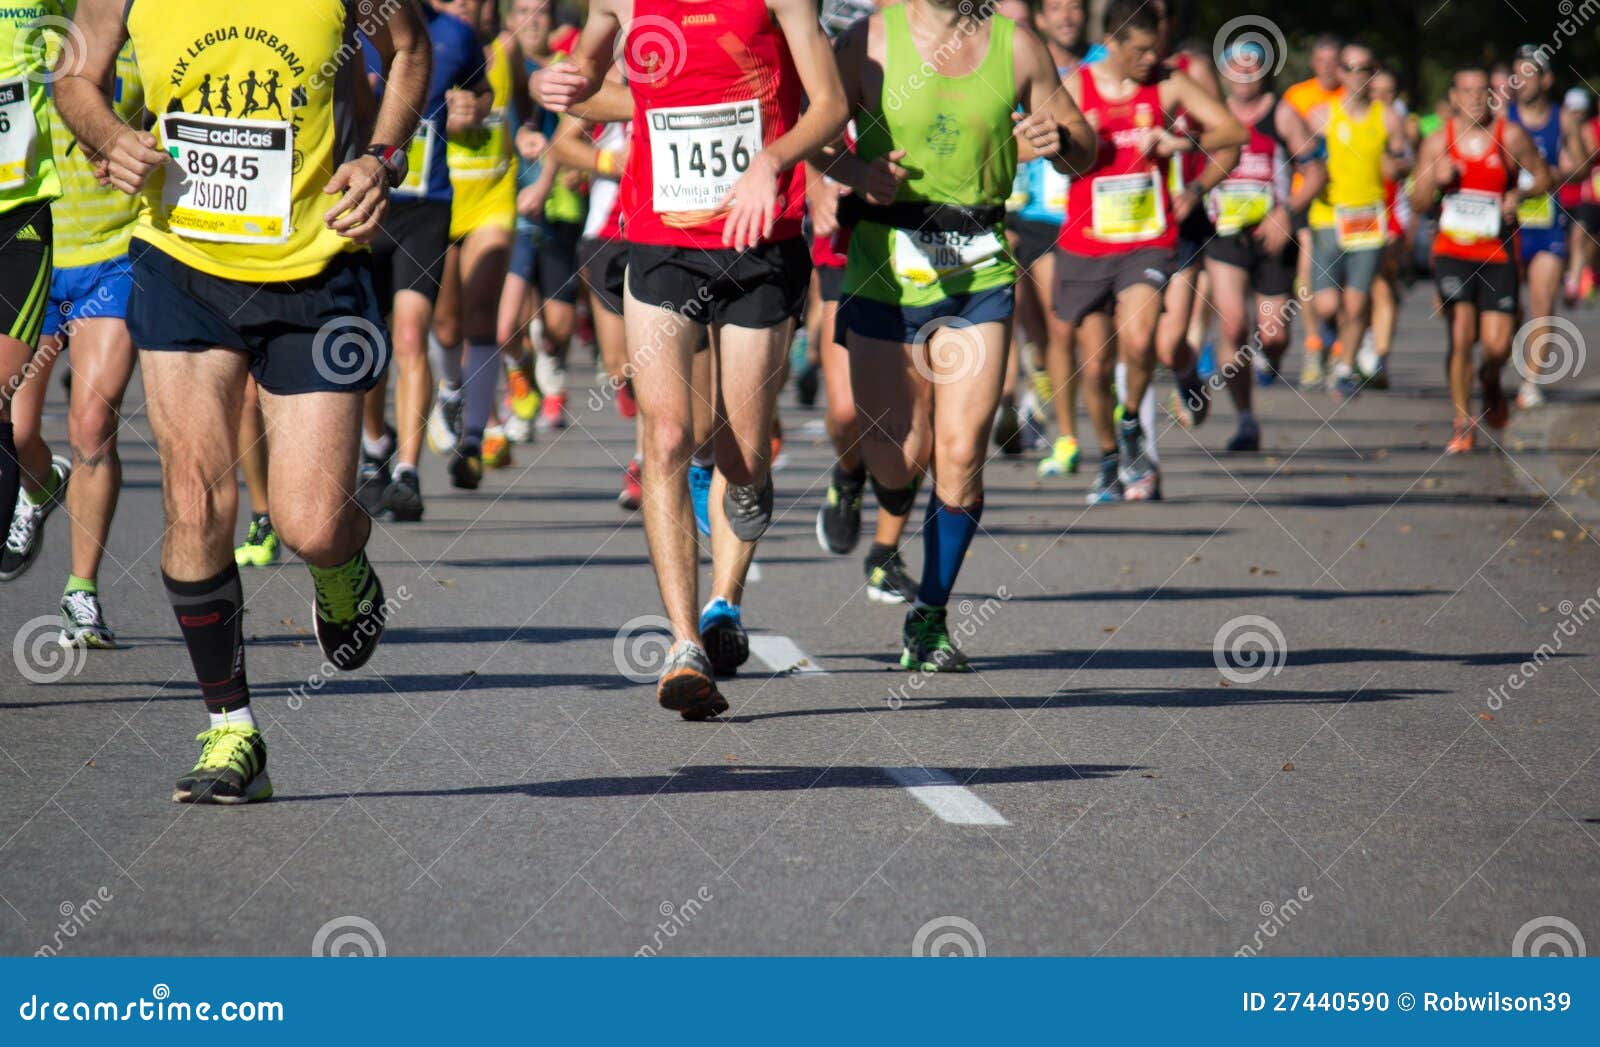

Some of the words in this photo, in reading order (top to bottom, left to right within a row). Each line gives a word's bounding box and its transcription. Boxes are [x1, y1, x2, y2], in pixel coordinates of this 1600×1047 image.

[171, 57, 190, 87] XIX
[187, 26, 239, 58] LEGUA
[244, 27, 305, 77] URBANA
[209, 128, 272, 147] adidas
[187, 149, 259, 181] 8945
[669, 136, 750, 179] 1456
[193, 180, 247, 211] ISIDRO
